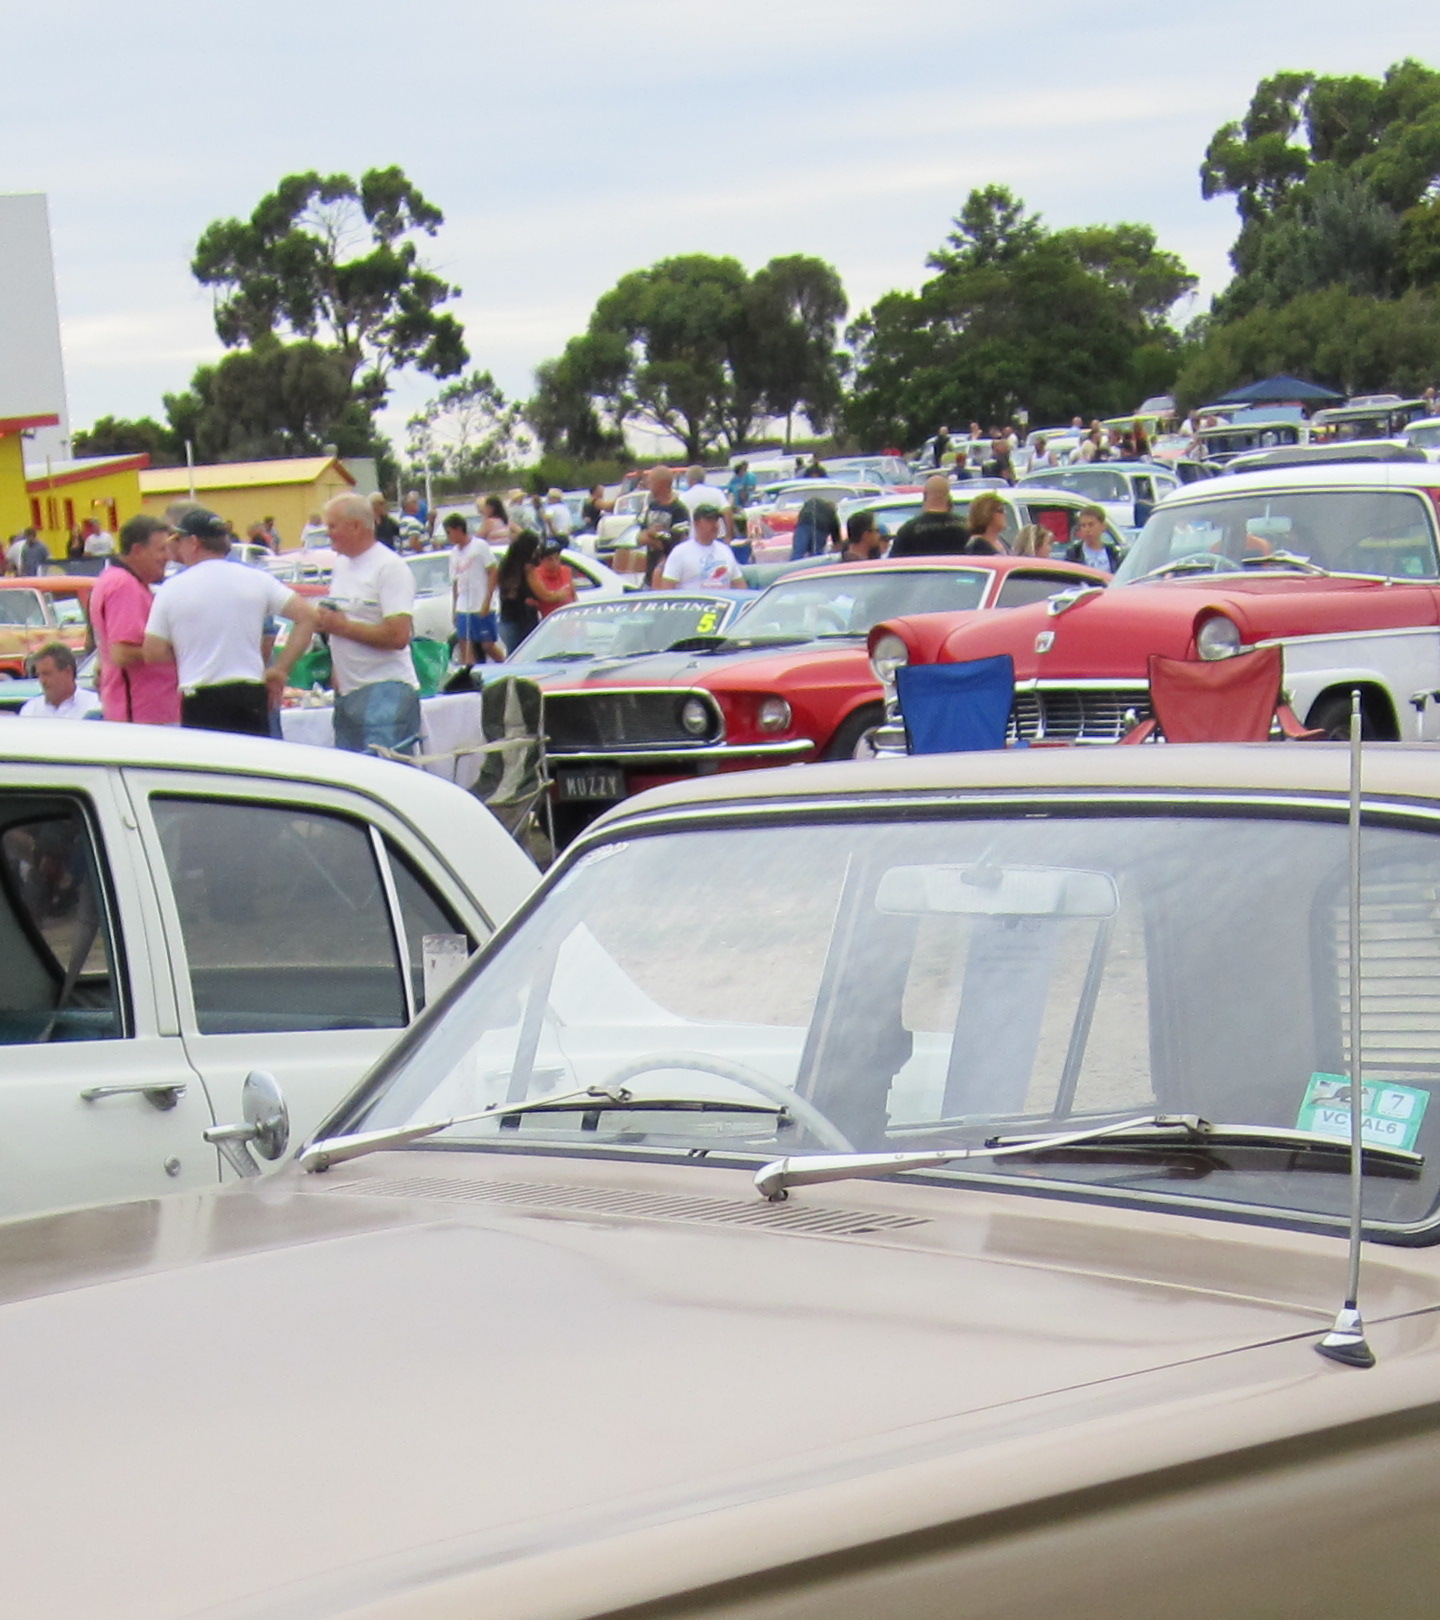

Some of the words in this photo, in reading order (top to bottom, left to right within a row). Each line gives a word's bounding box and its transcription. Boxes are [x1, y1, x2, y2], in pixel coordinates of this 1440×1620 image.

[549, 603, 627, 623] MUSTANG
[644, 601, 717, 613] RACING
[1391, 1094, 1406, 1111] 7
[1322, 1110, 1399, 1135] VCAL6
